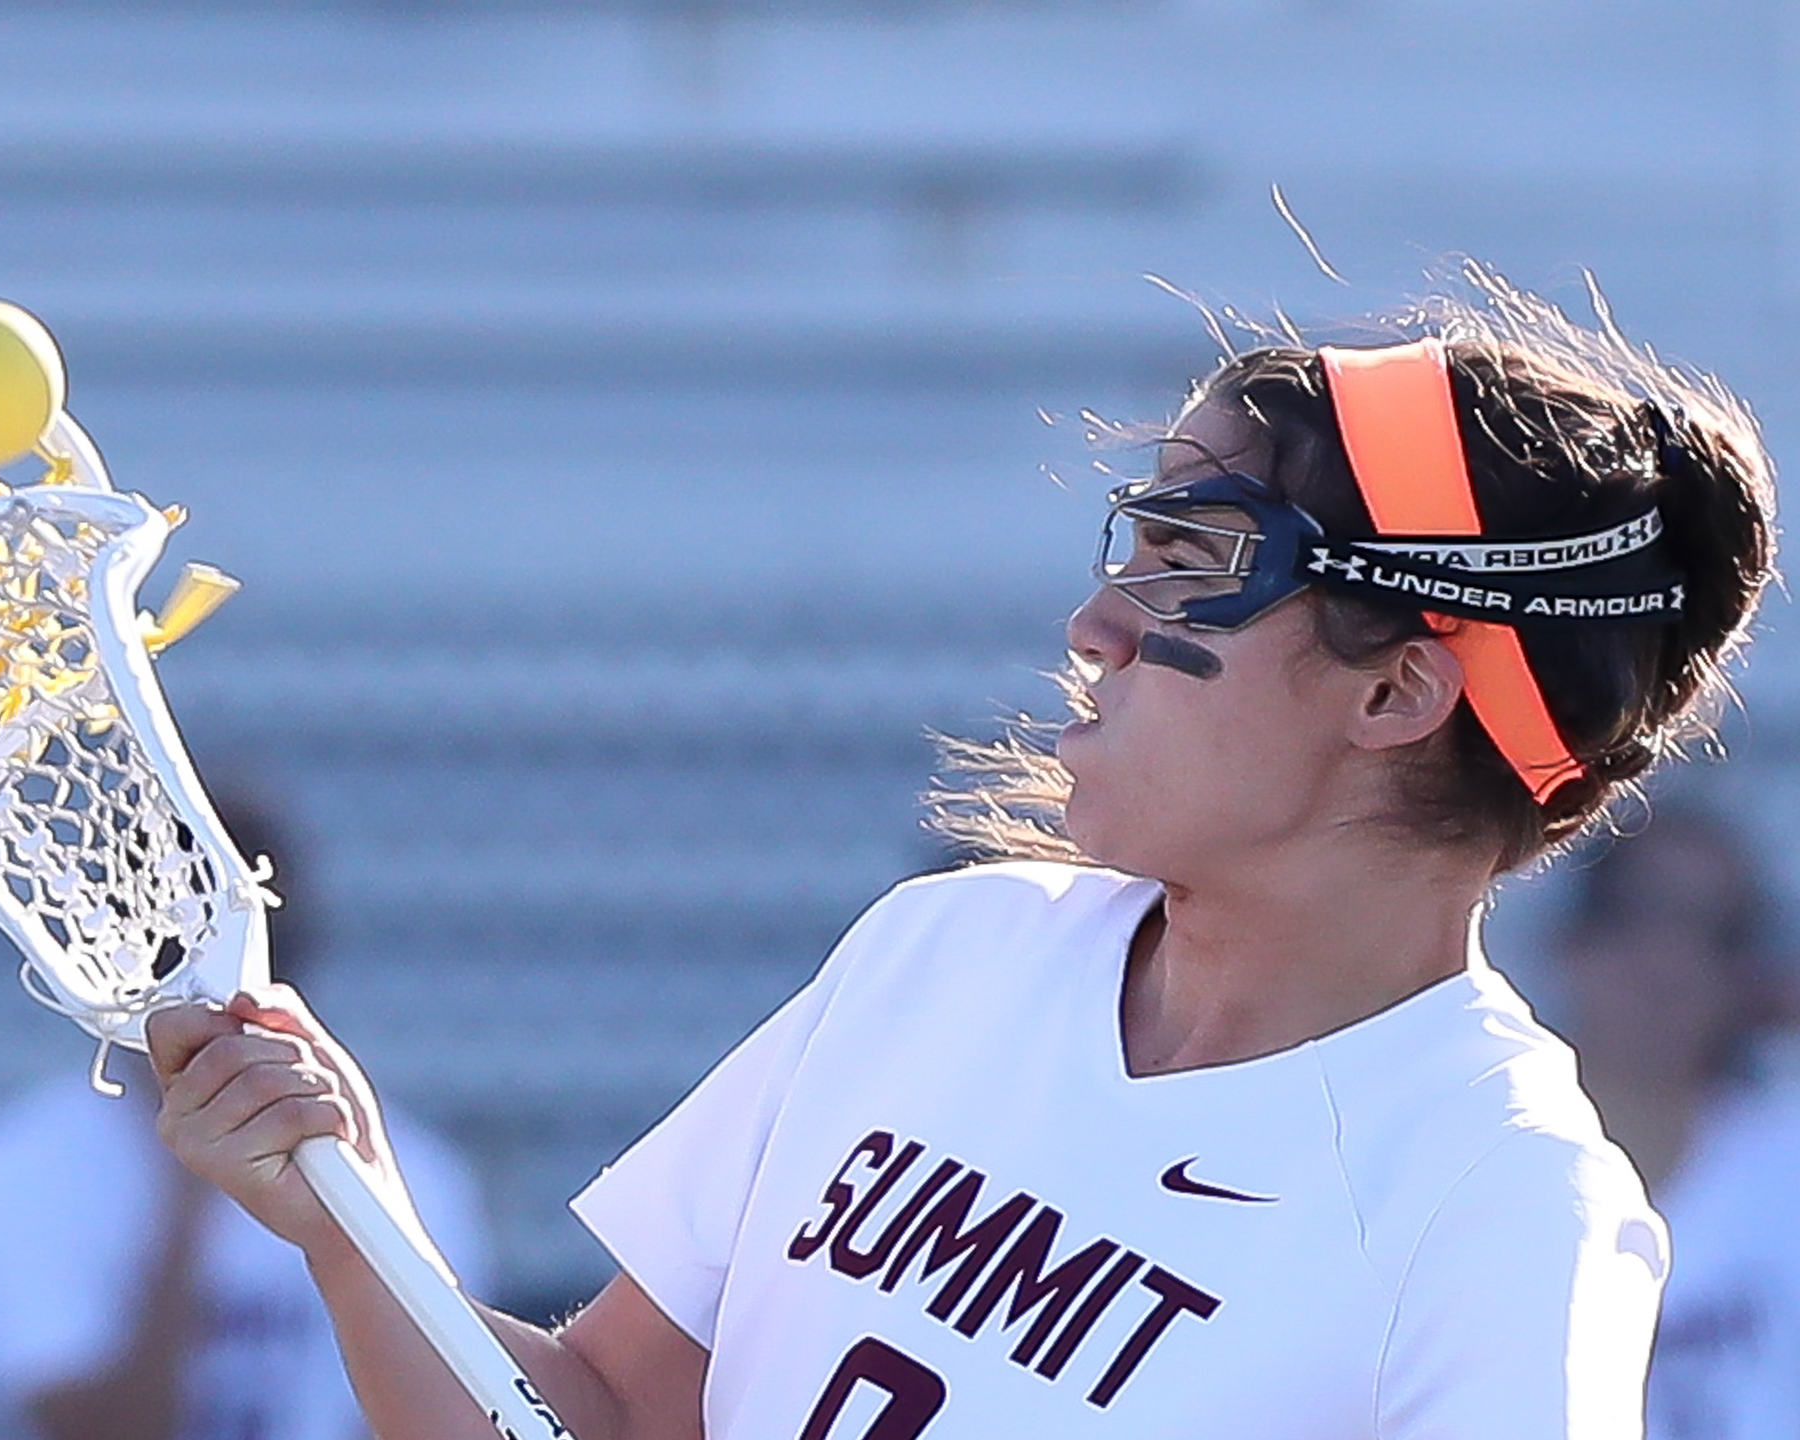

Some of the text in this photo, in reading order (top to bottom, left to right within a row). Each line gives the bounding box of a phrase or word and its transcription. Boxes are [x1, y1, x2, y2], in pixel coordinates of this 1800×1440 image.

[1372, 567, 1664, 617] UNDER ARMOUR
[788, 1130, 1222, 1409] SUMMIT
